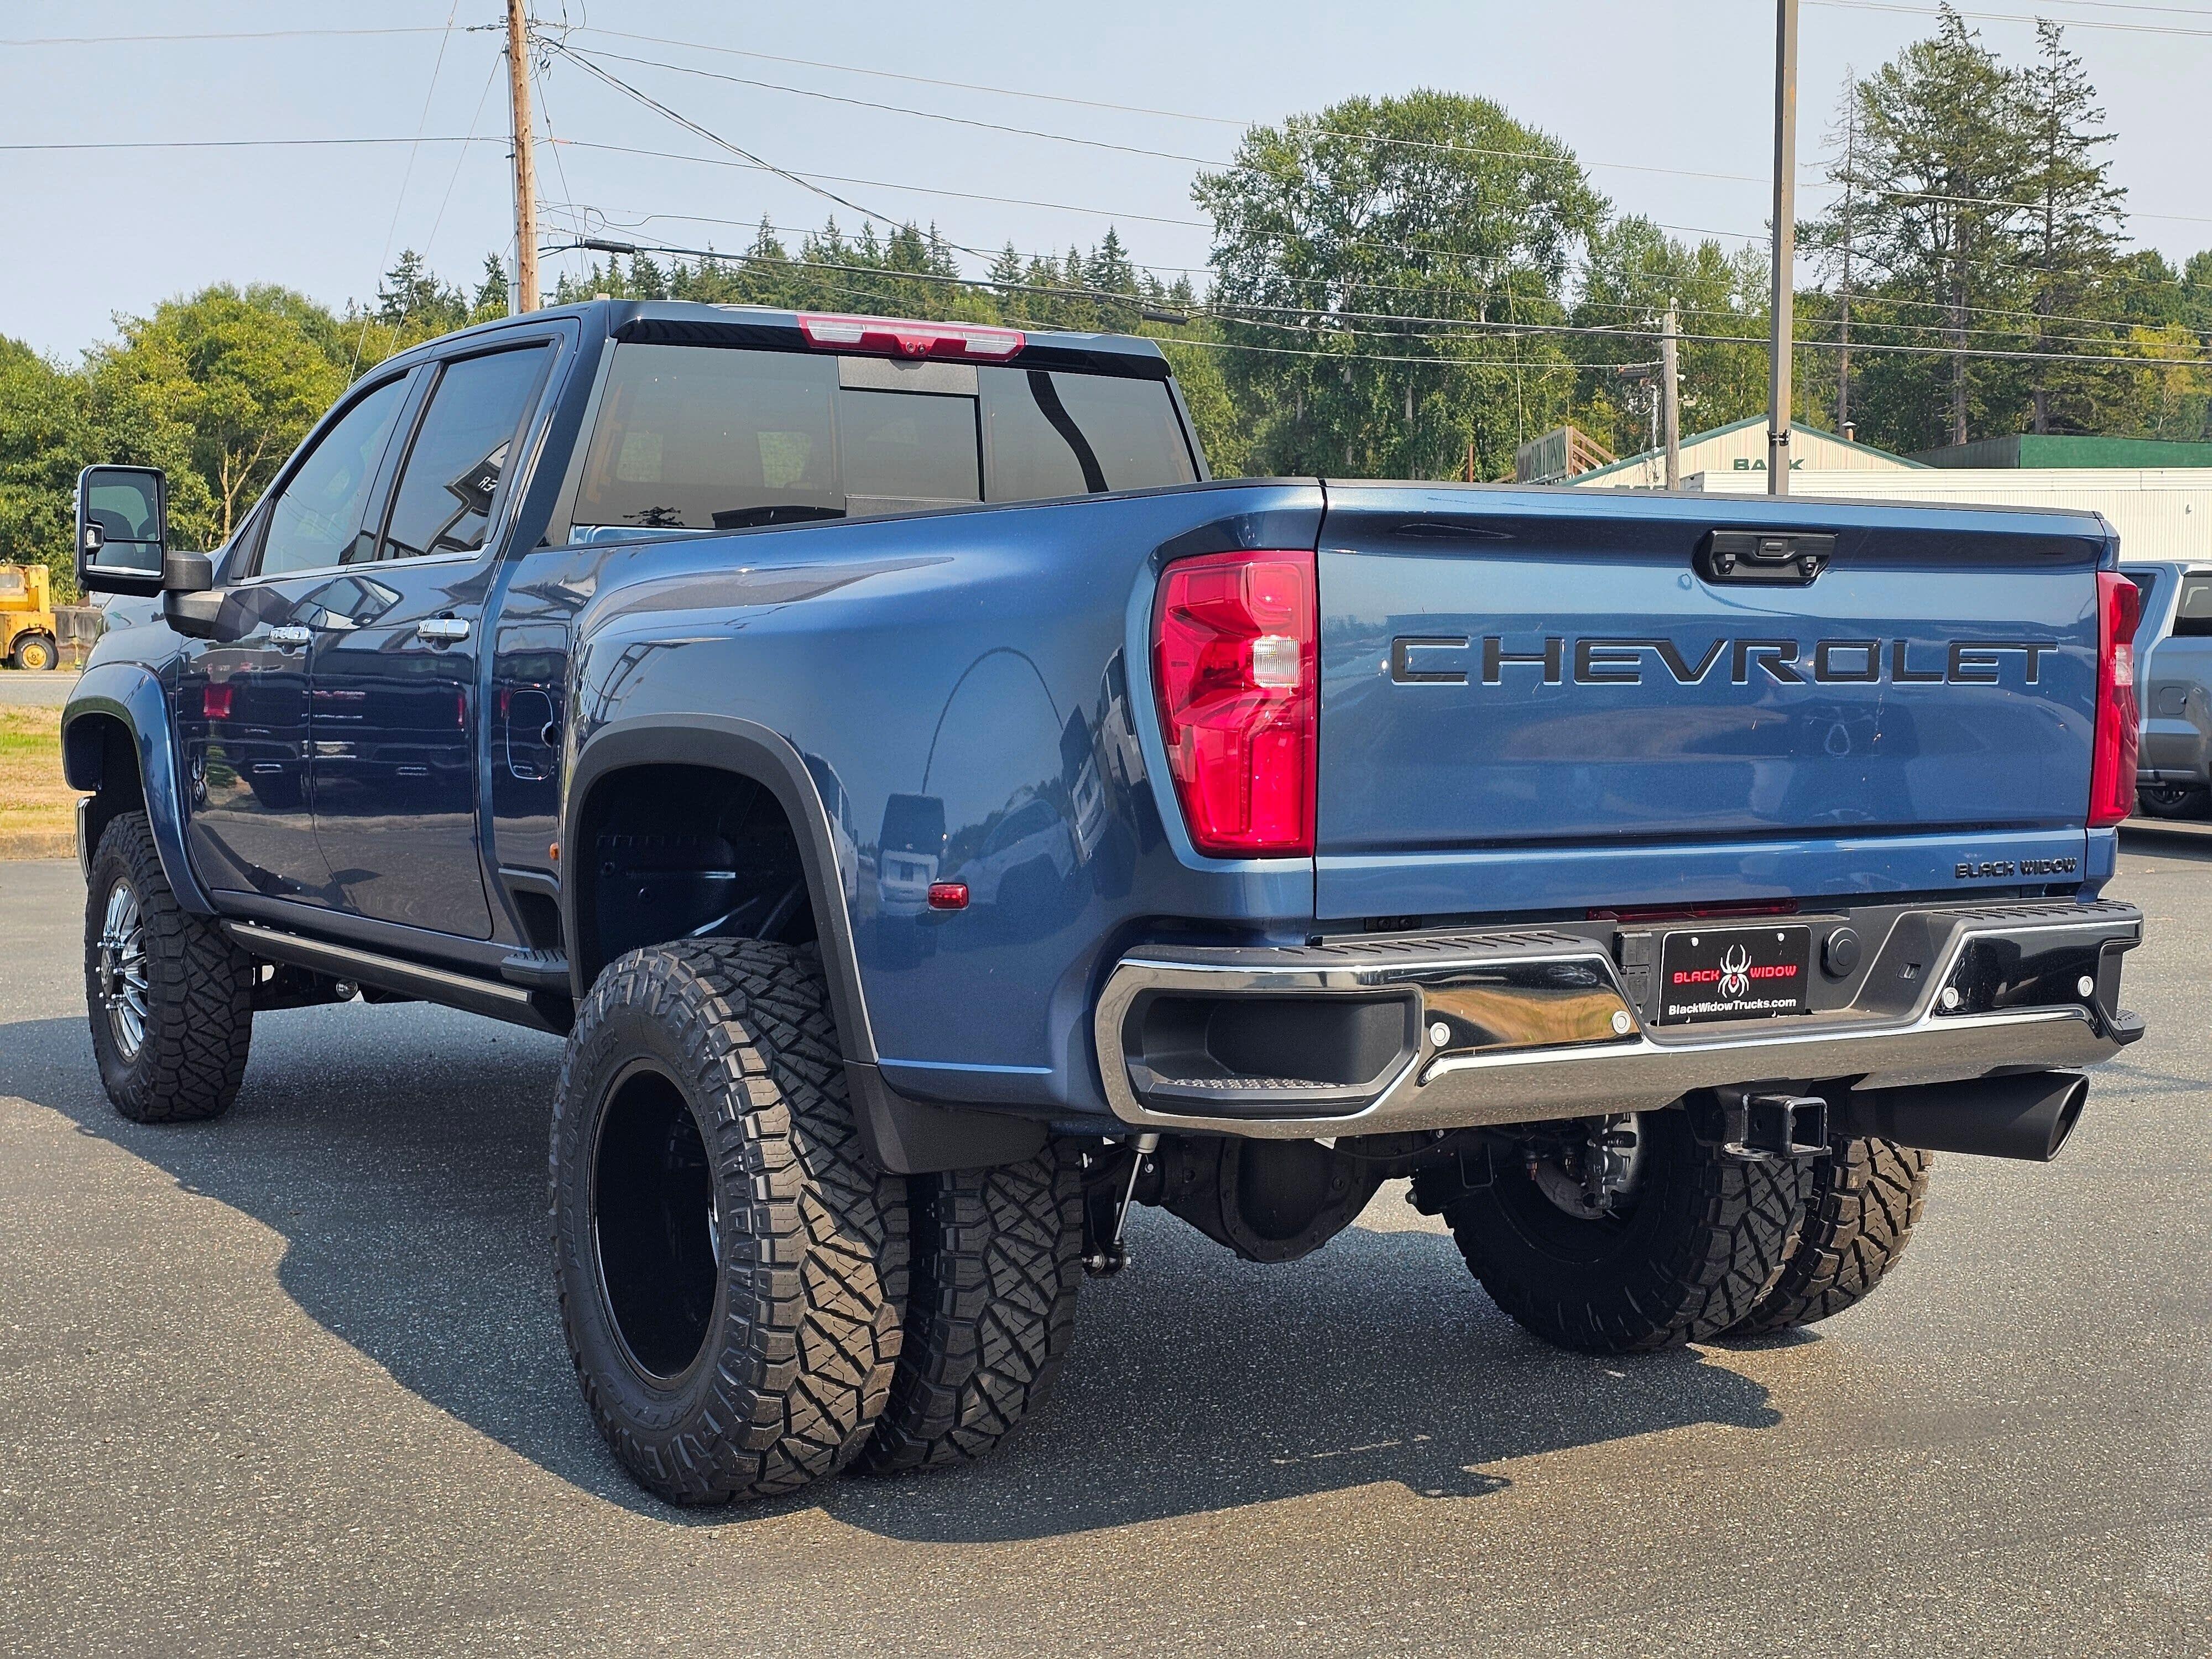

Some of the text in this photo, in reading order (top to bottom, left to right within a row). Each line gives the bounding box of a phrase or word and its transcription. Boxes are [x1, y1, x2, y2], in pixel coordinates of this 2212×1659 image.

[1734, 458, 1805, 471] BAK
[1390, 635, 2059, 686] CHEVROLET
[1955, 857, 2077, 879] BLACK WIDOW
[1673, 965, 1797, 984] BLACK WIDOW
[1668, 998, 1797, 1016] BlackWidowTrucks.com
